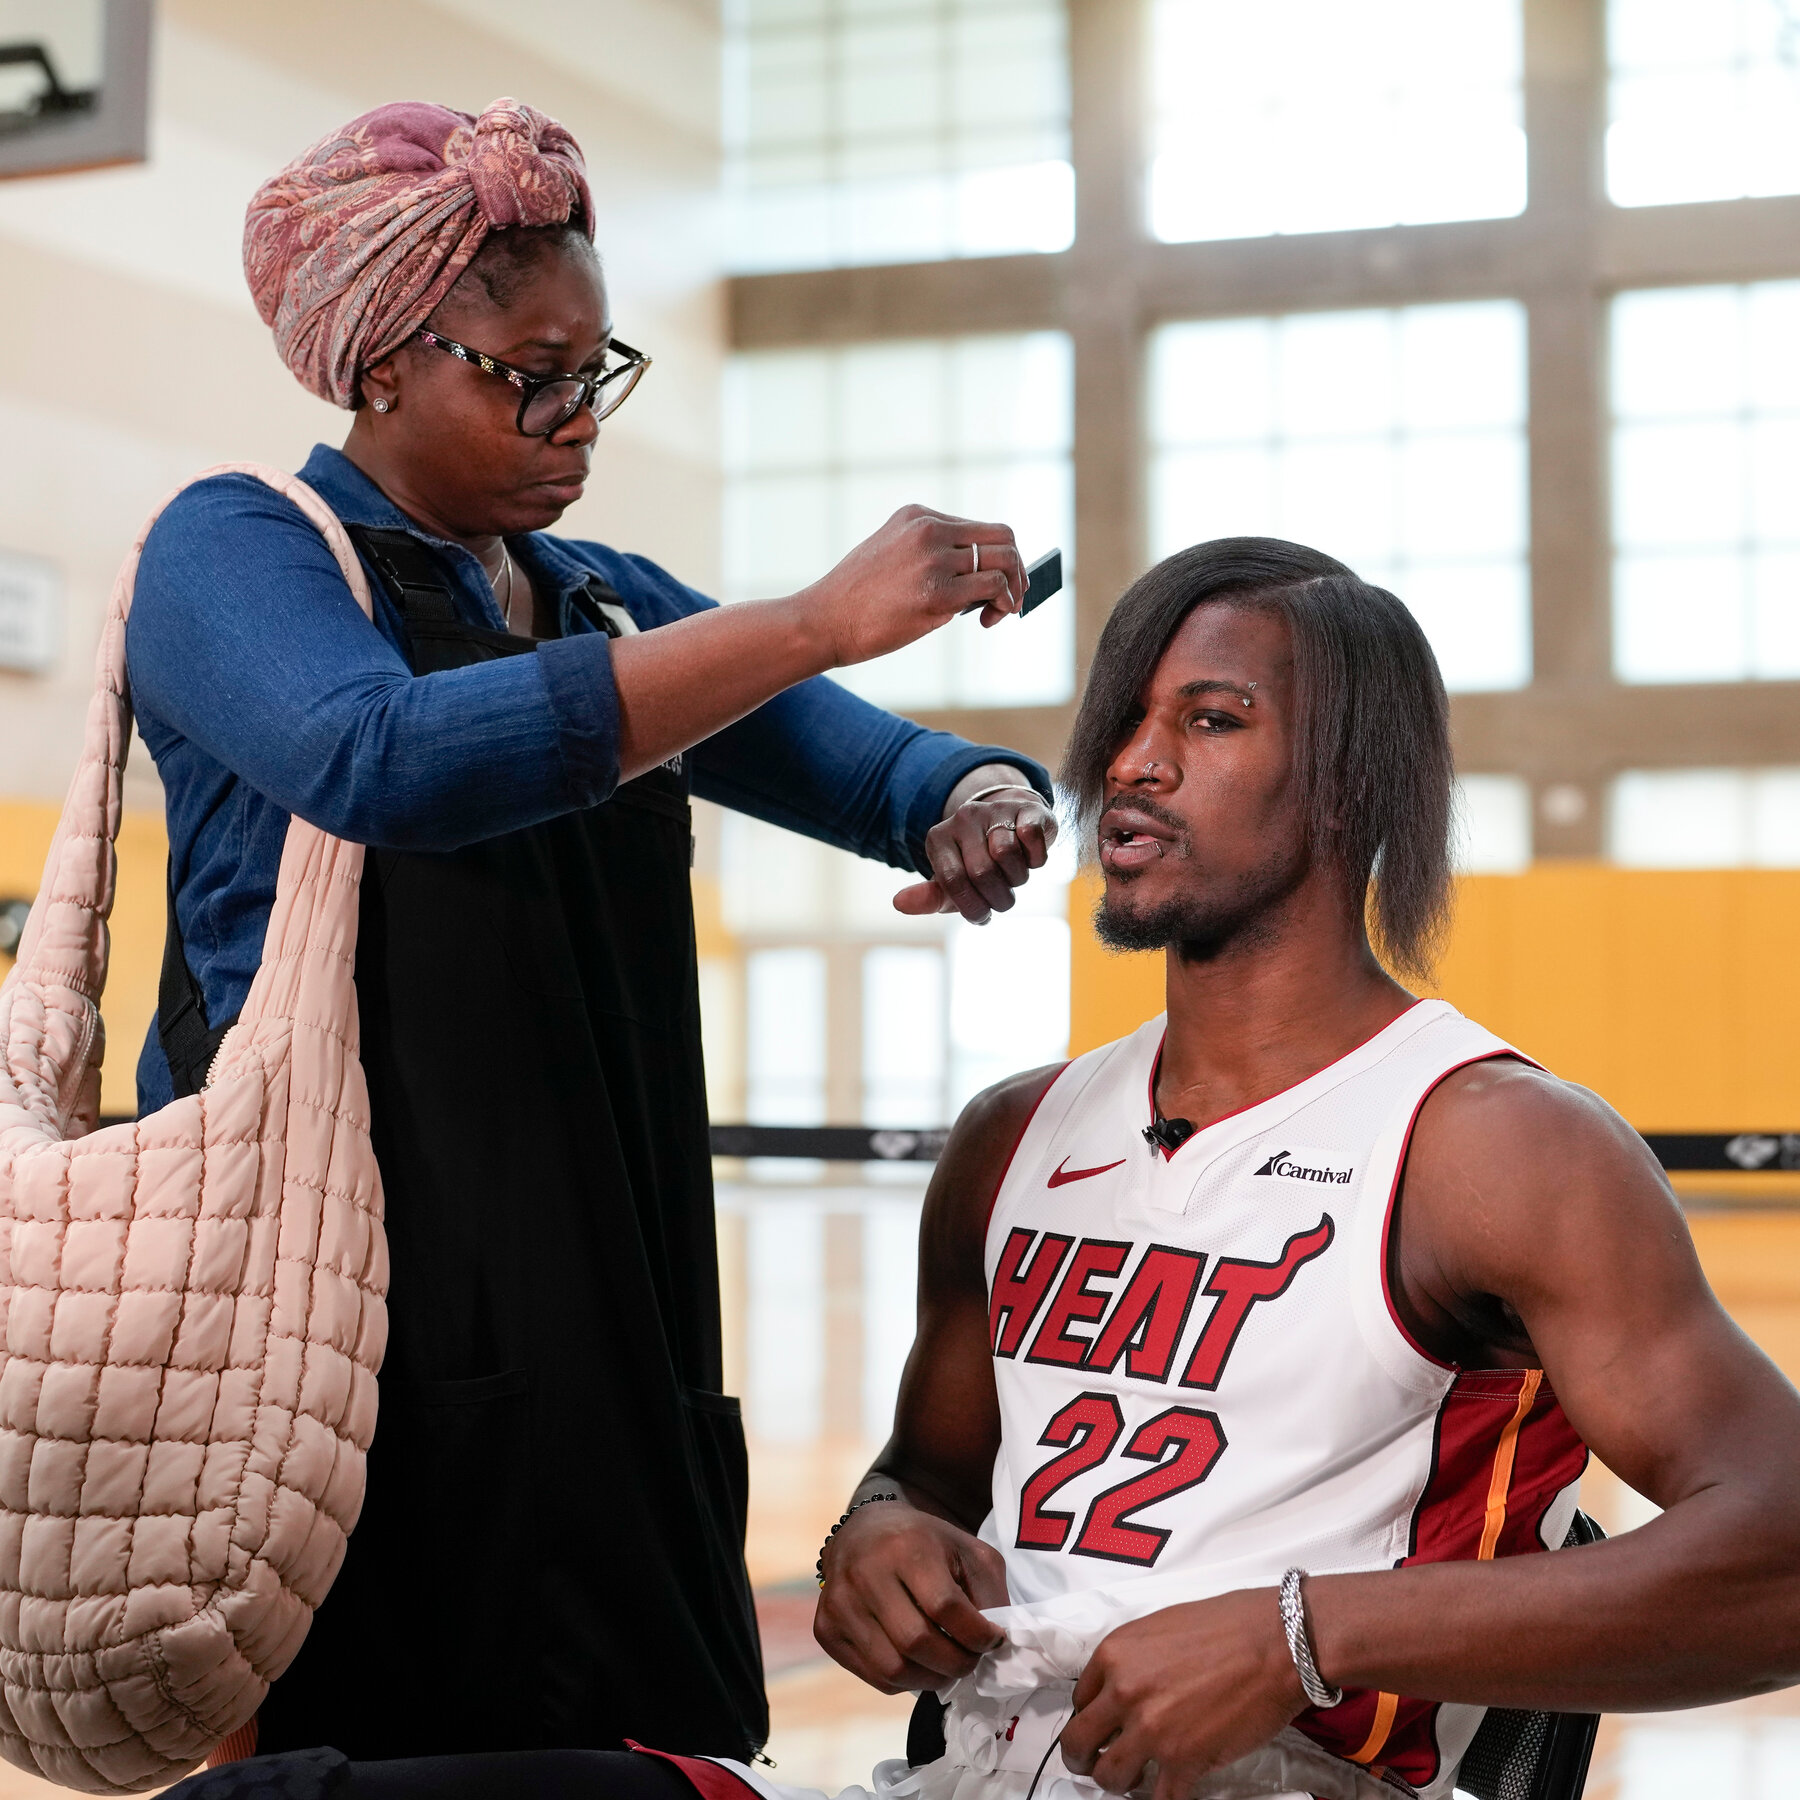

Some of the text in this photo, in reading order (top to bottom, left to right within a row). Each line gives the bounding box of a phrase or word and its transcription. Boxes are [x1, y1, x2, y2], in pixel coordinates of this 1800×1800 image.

[1276, 1162, 1354, 1184] Carnival
[990, 1212, 1335, 1391] HEAT
[1015, 1391, 1229, 1568] 22
